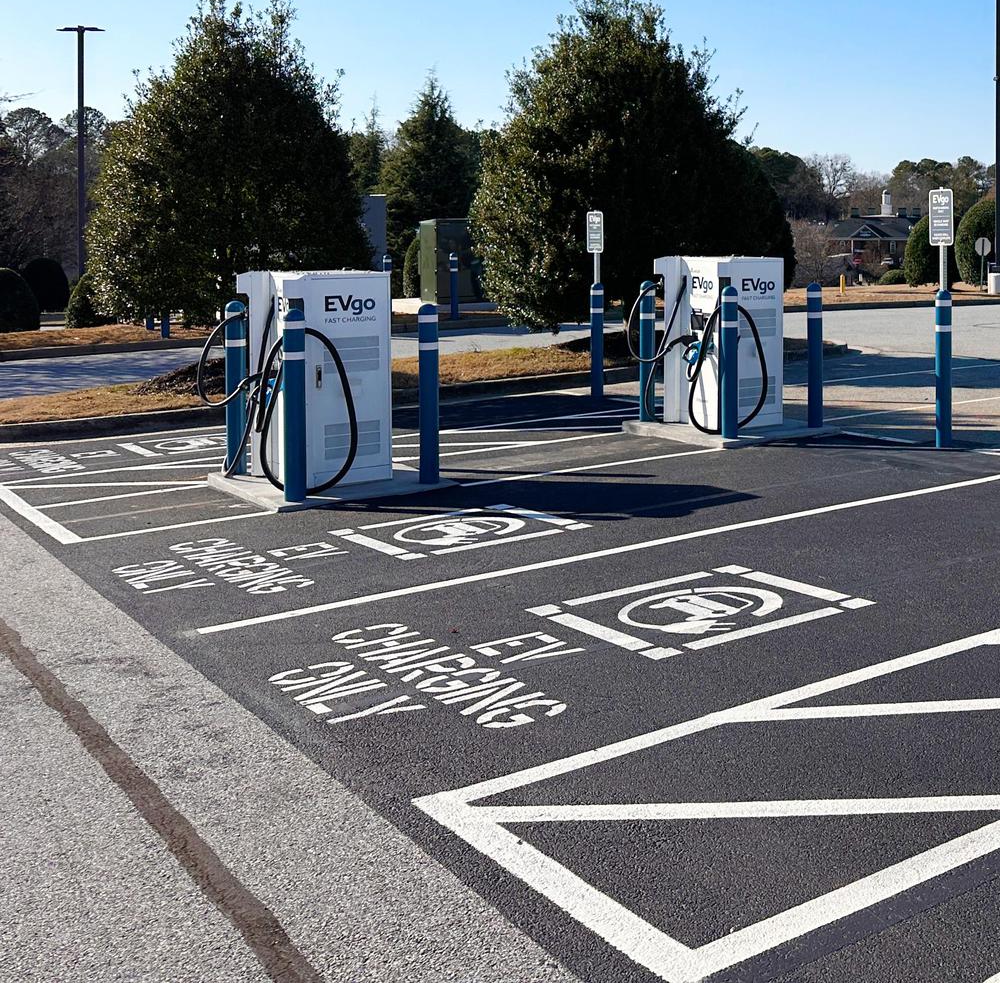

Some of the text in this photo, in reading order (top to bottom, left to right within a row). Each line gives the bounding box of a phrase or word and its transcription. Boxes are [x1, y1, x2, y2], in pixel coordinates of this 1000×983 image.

[932, 194, 950, 205] EVgo
[692, 276, 713, 293] EVgo
[742, 278, 775, 294] EVgo
[325, 295, 376, 315] EVgo
[267, 542, 349, 561] EV
[112, 560, 215, 595] ONLY
[168, 537, 315, 595] CHARGING
[470, 632, 587, 664] EV
[331, 623, 567, 728] CHARGING
[268, 661, 427, 724] ONLY
